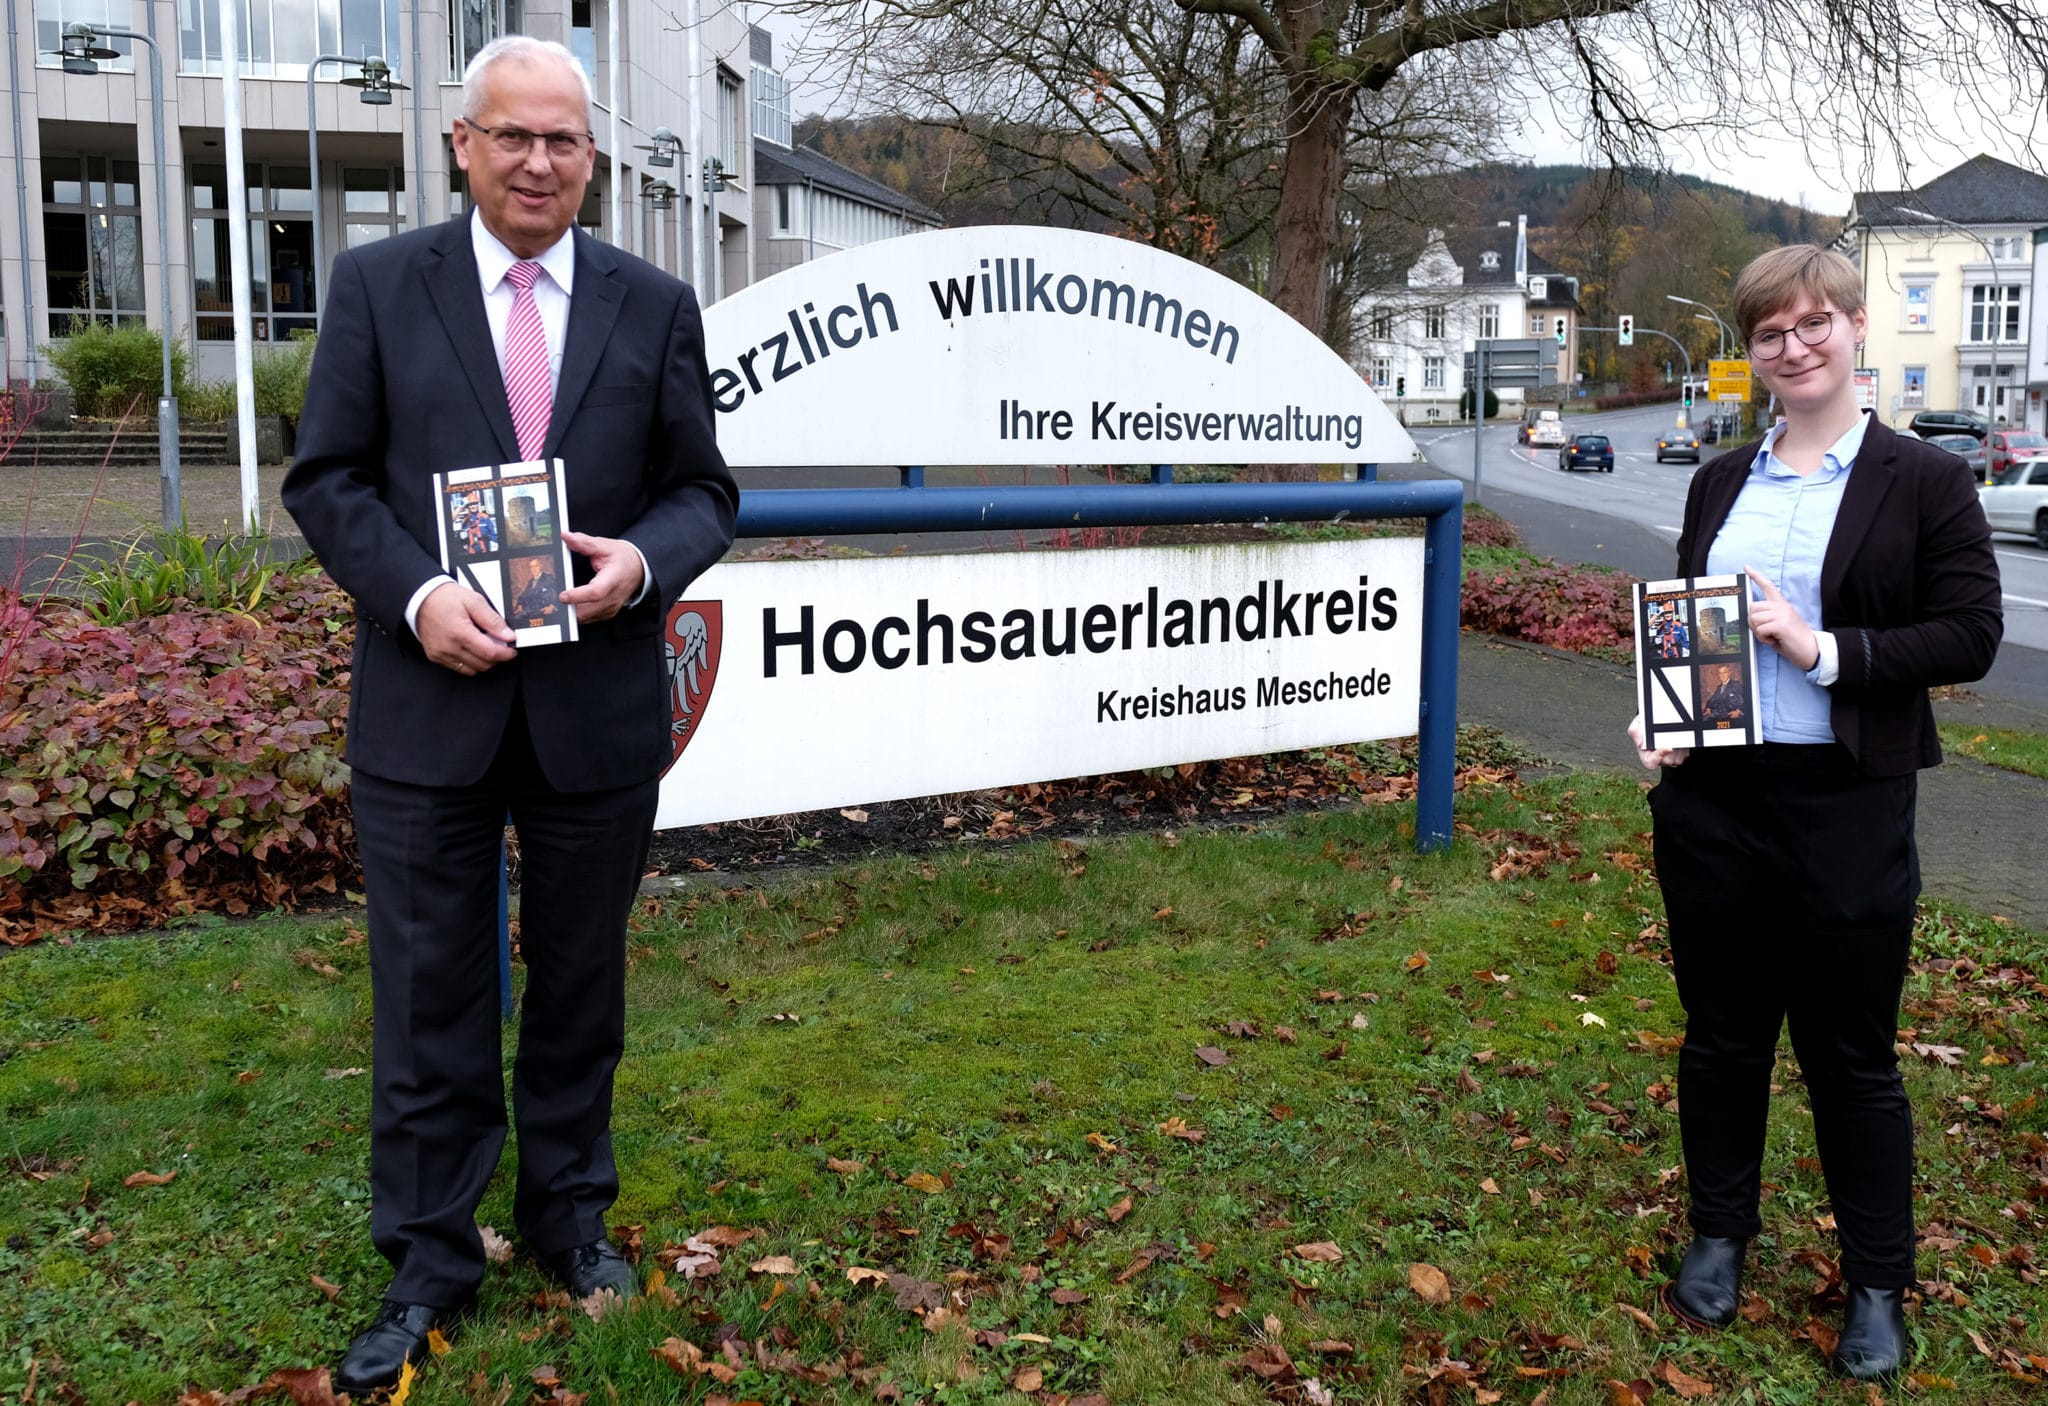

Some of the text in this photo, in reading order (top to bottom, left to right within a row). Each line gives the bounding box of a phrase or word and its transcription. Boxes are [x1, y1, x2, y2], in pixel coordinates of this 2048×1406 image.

[710, 258, 1240, 413] erzlich willkommen
[1000, 399, 1362, 450] Ihre Kreisverwaltung
[528, 618, 544, 628] 2021
[762, 574, 1398, 679] Hochsauerlandkreis
[1097, 667, 1391, 724] Kreishaus Meschede
[1716, 720, 1731, 730] 2021
